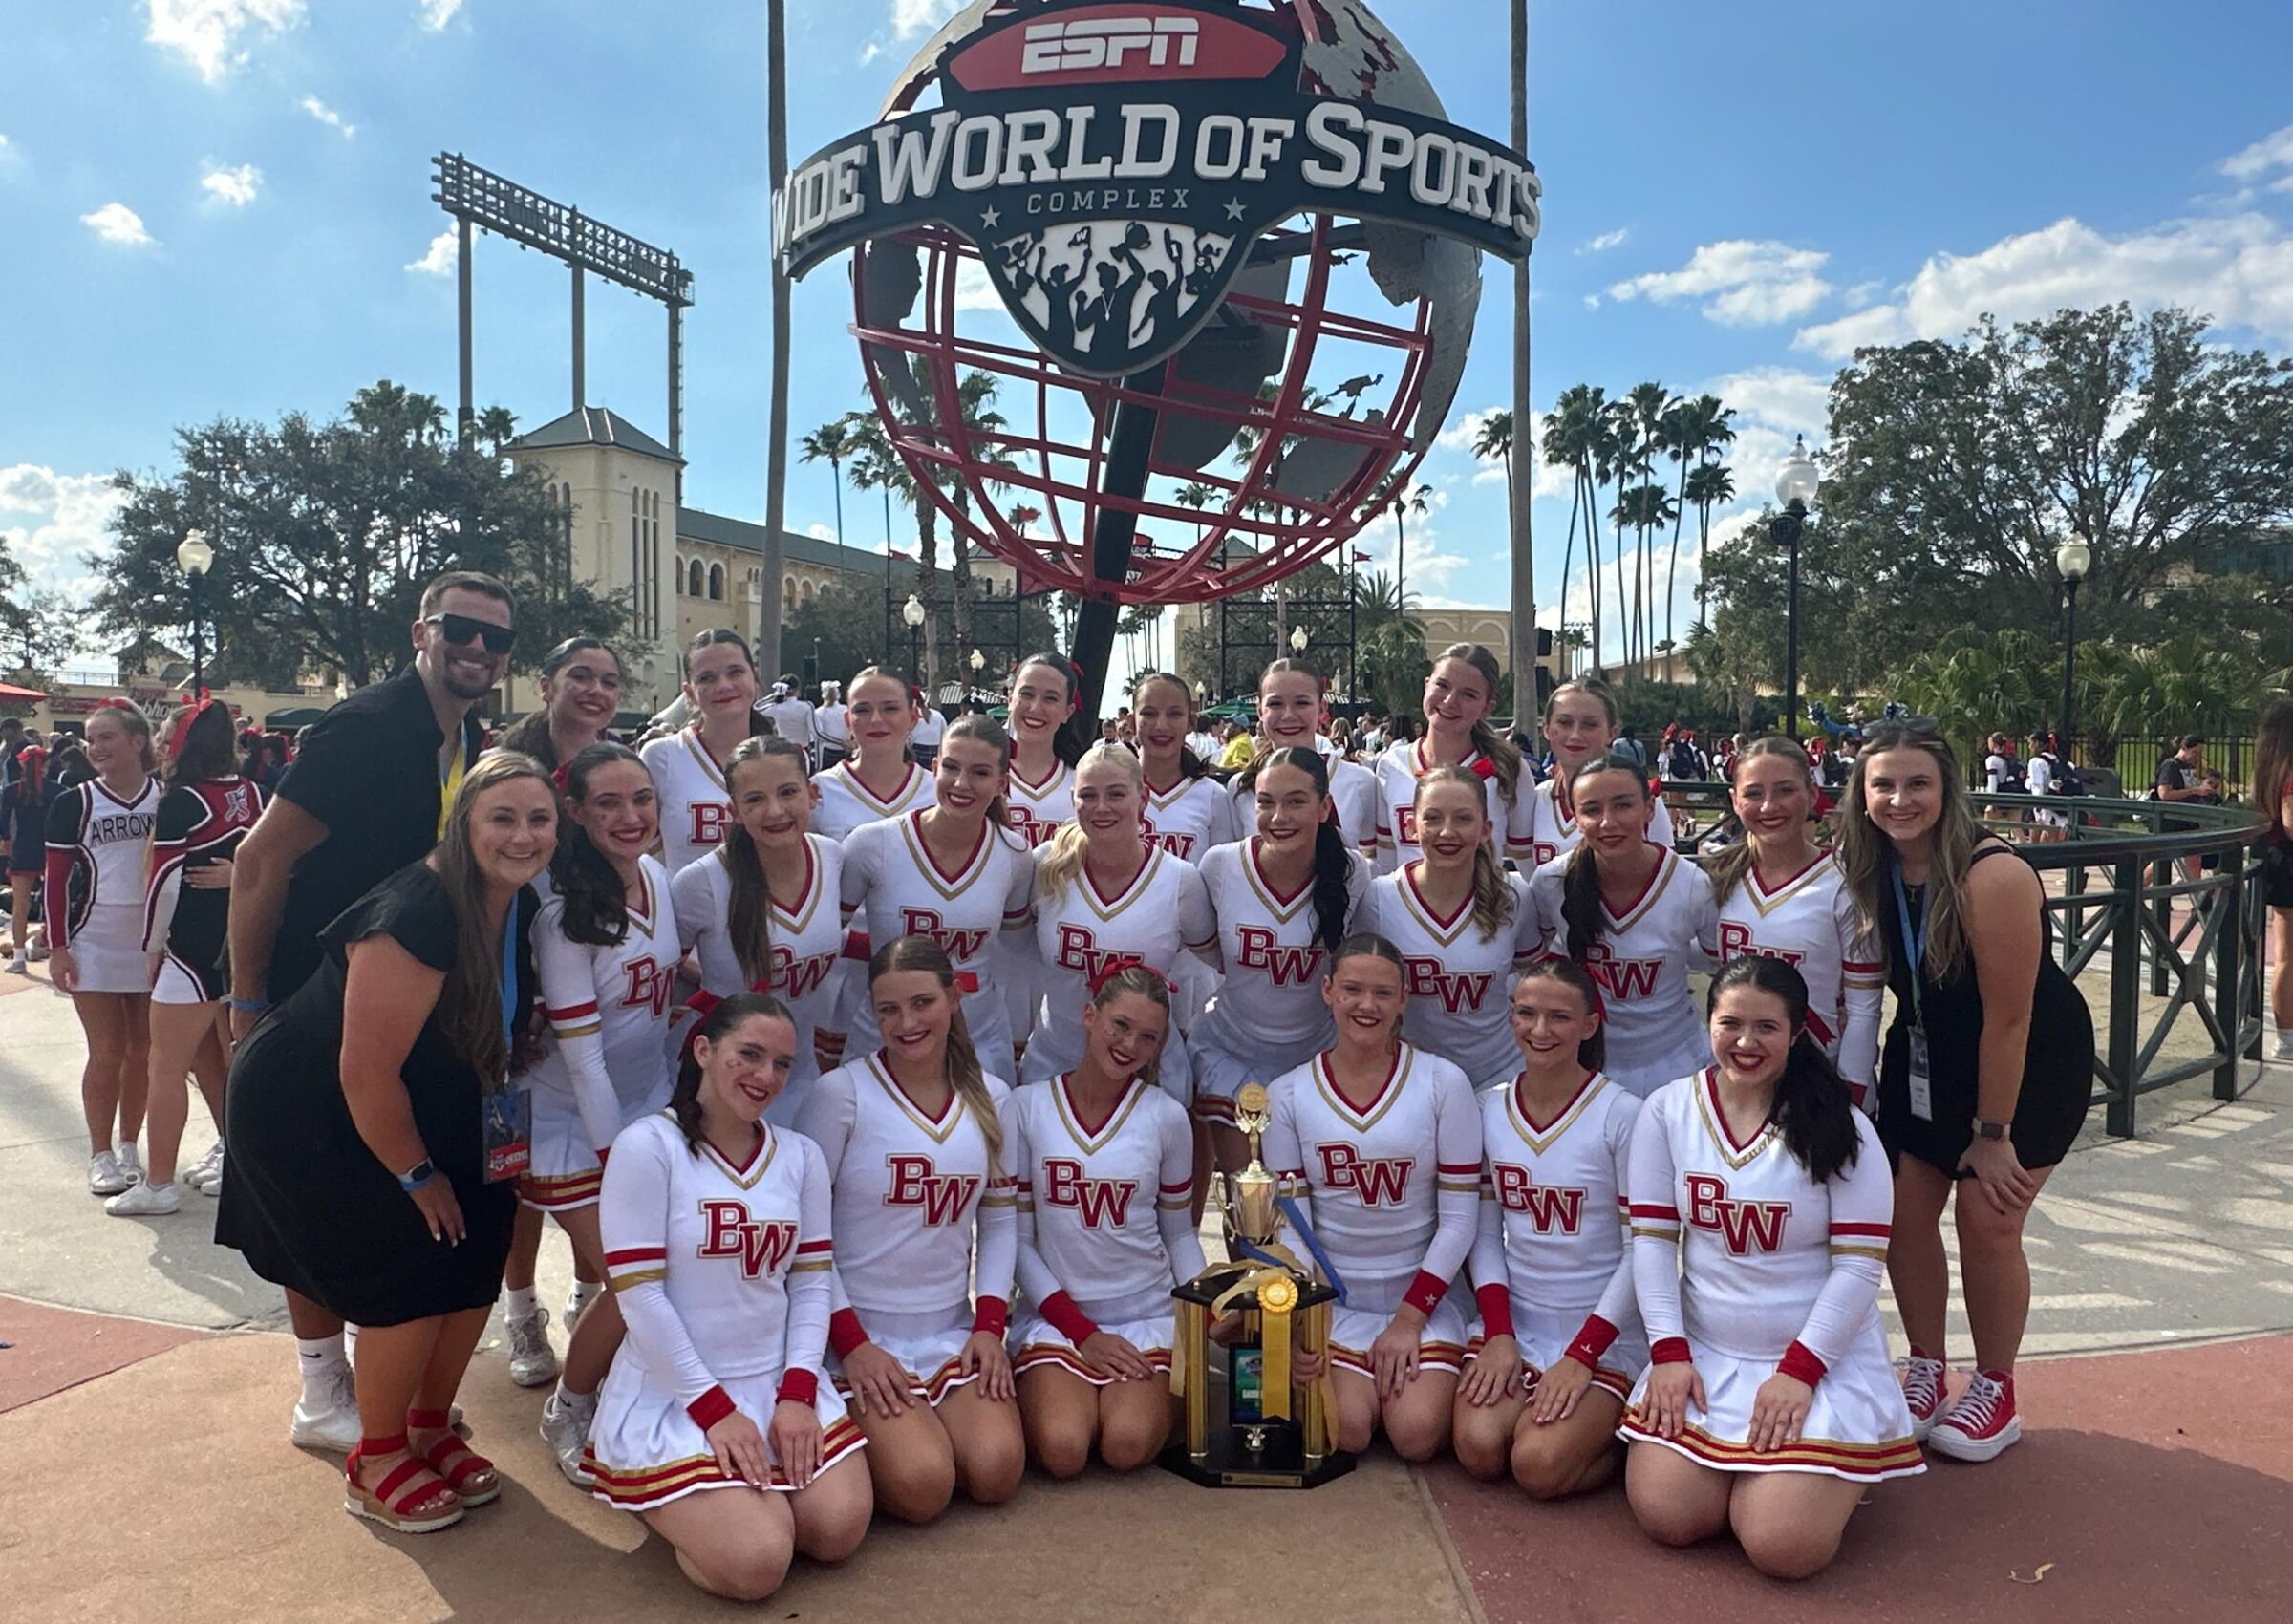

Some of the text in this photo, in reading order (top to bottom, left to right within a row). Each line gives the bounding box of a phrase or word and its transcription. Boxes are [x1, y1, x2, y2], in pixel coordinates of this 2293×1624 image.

[1021, 16, 1199, 75] ESPN
[772, 101, 1543, 261] WIDE WORLD OF SPORTS
[1026, 188, 1189, 215] COMPLEX
[688, 801, 732, 846] B
[1236, 923, 1326, 988] BW
[1403, 955, 1497, 1015] BW
[882, 1153, 982, 1228] BW
[1042, 1156, 1140, 1230] BW
[1314, 1141, 1416, 1208] BW
[1492, 1161, 1589, 1236] BW
[697, 1198, 800, 1281] BW
[1683, 1170, 1792, 1257] BW
